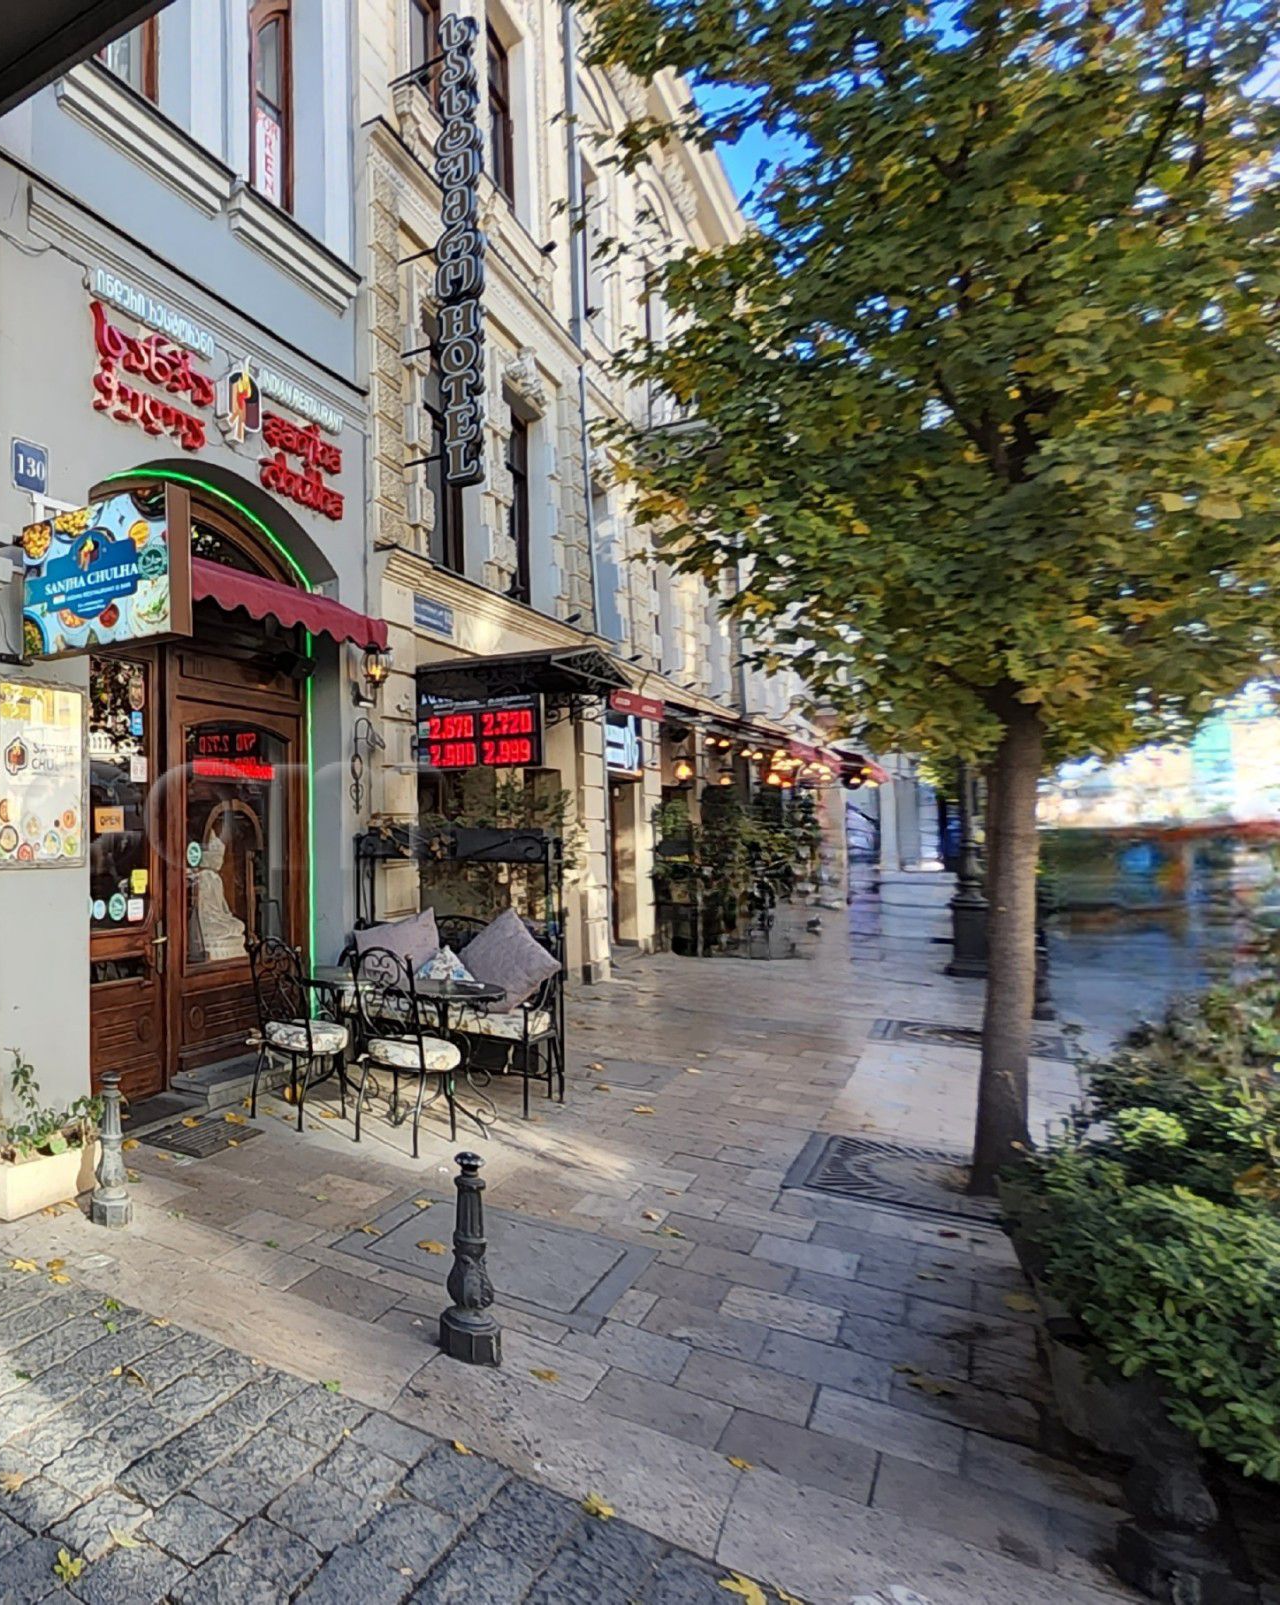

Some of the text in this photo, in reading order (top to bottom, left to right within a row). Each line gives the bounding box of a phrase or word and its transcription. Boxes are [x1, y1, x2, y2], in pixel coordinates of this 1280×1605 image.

[436, 13, 477, 298] სასტუმრო
[439, 300, 478, 480] HOTEL
[17, 453, 45, 481] 130
[45, 576, 86, 595] SANJHA
[87, 563, 139, 584] CHULHA
[481, 709, 533, 736] 2.720
[99, 815, 121, 827] OPEN
